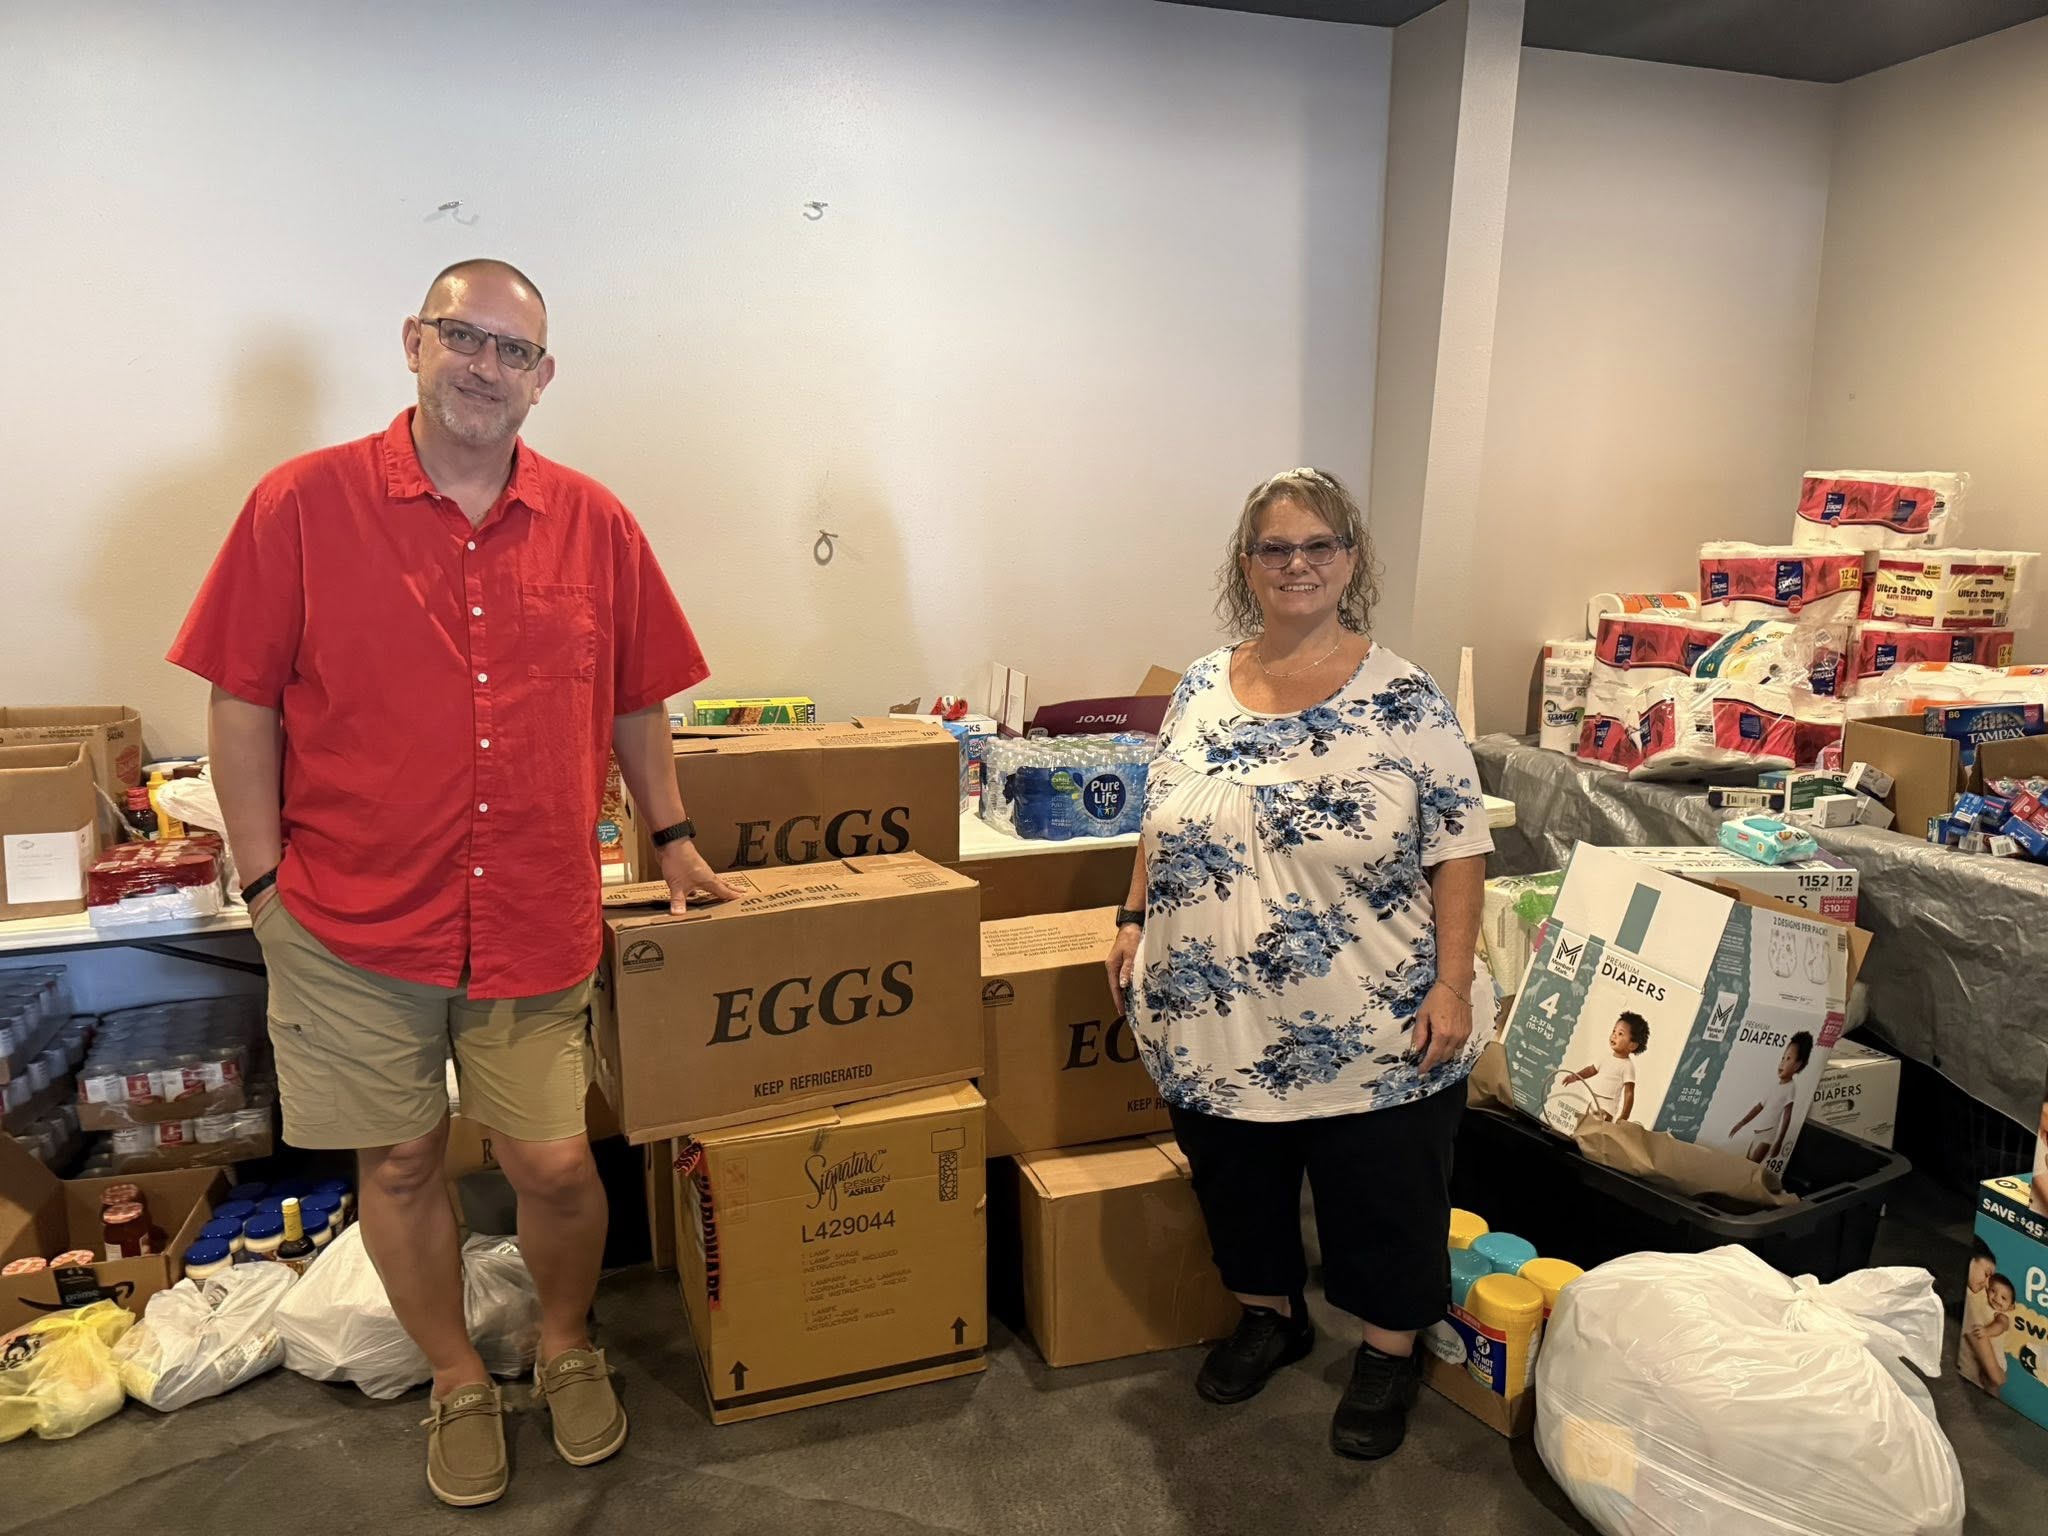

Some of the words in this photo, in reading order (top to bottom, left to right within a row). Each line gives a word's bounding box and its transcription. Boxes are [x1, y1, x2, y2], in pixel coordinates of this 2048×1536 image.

[1876, 583, 1898, 594] Ultra
[1900, 585, 1933, 600] Strong
[1958, 589, 1978, 598] Ultra
[1980, 589, 2005, 600] Strong
[1075, 713, 1128, 725] flavor
[1968, 727, 2026, 744] TAMPAX
[1091, 780, 1120, 792] Pure
[1094, 792, 1118, 807] Life
[728, 806, 910, 869] EGGS
[803, 883, 844, 894] THIS
[1798, 875, 1829, 887] 1152
[1837, 875, 1853, 887] 12
[766, 887, 803, 899] SIDE
[740, 897, 764, 907] UP
[1824, 904, 1841, 913] $10
[1778, 918, 1801, 931] DESIGNS
[1801, 923, 1812, 932] PER
[1551, 958, 1575, 974] Member's
[1605, 955, 1640, 975] PREMIUM
[1601, 963, 1667, 1002] DIAPERS
[705, 960, 914, 1047] EGGS
[1538, 992, 1561, 1019] 4
[1061, 1015, 1141, 1071] EG
[1739, 1028, 1788, 1048] DIAPERS
[1691, 1057, 1711, 1085] 4
[754, 1080, 784, 1098] KEEP
[790, 1064, 873, 1091] REFRIGERATED
[1813, 1084, 1862, 1102] DIAPERS
[1127, 1097, 1152, 1112] KEEP
[1765, 1159, 1783, 1173] 198
[805, 1151, 884, 1211] Signature
[843, 1174, 891, 1190] DESIGN
[848, 1184, 885, 1197] ASHLEY
[1982, 1198, 2016, 1223] SAVE
[802, 1209, 896, 1243] L429044
[65, 1290, 100, 1303] prime
[1481, 1356, 1494, 1368] NOT
